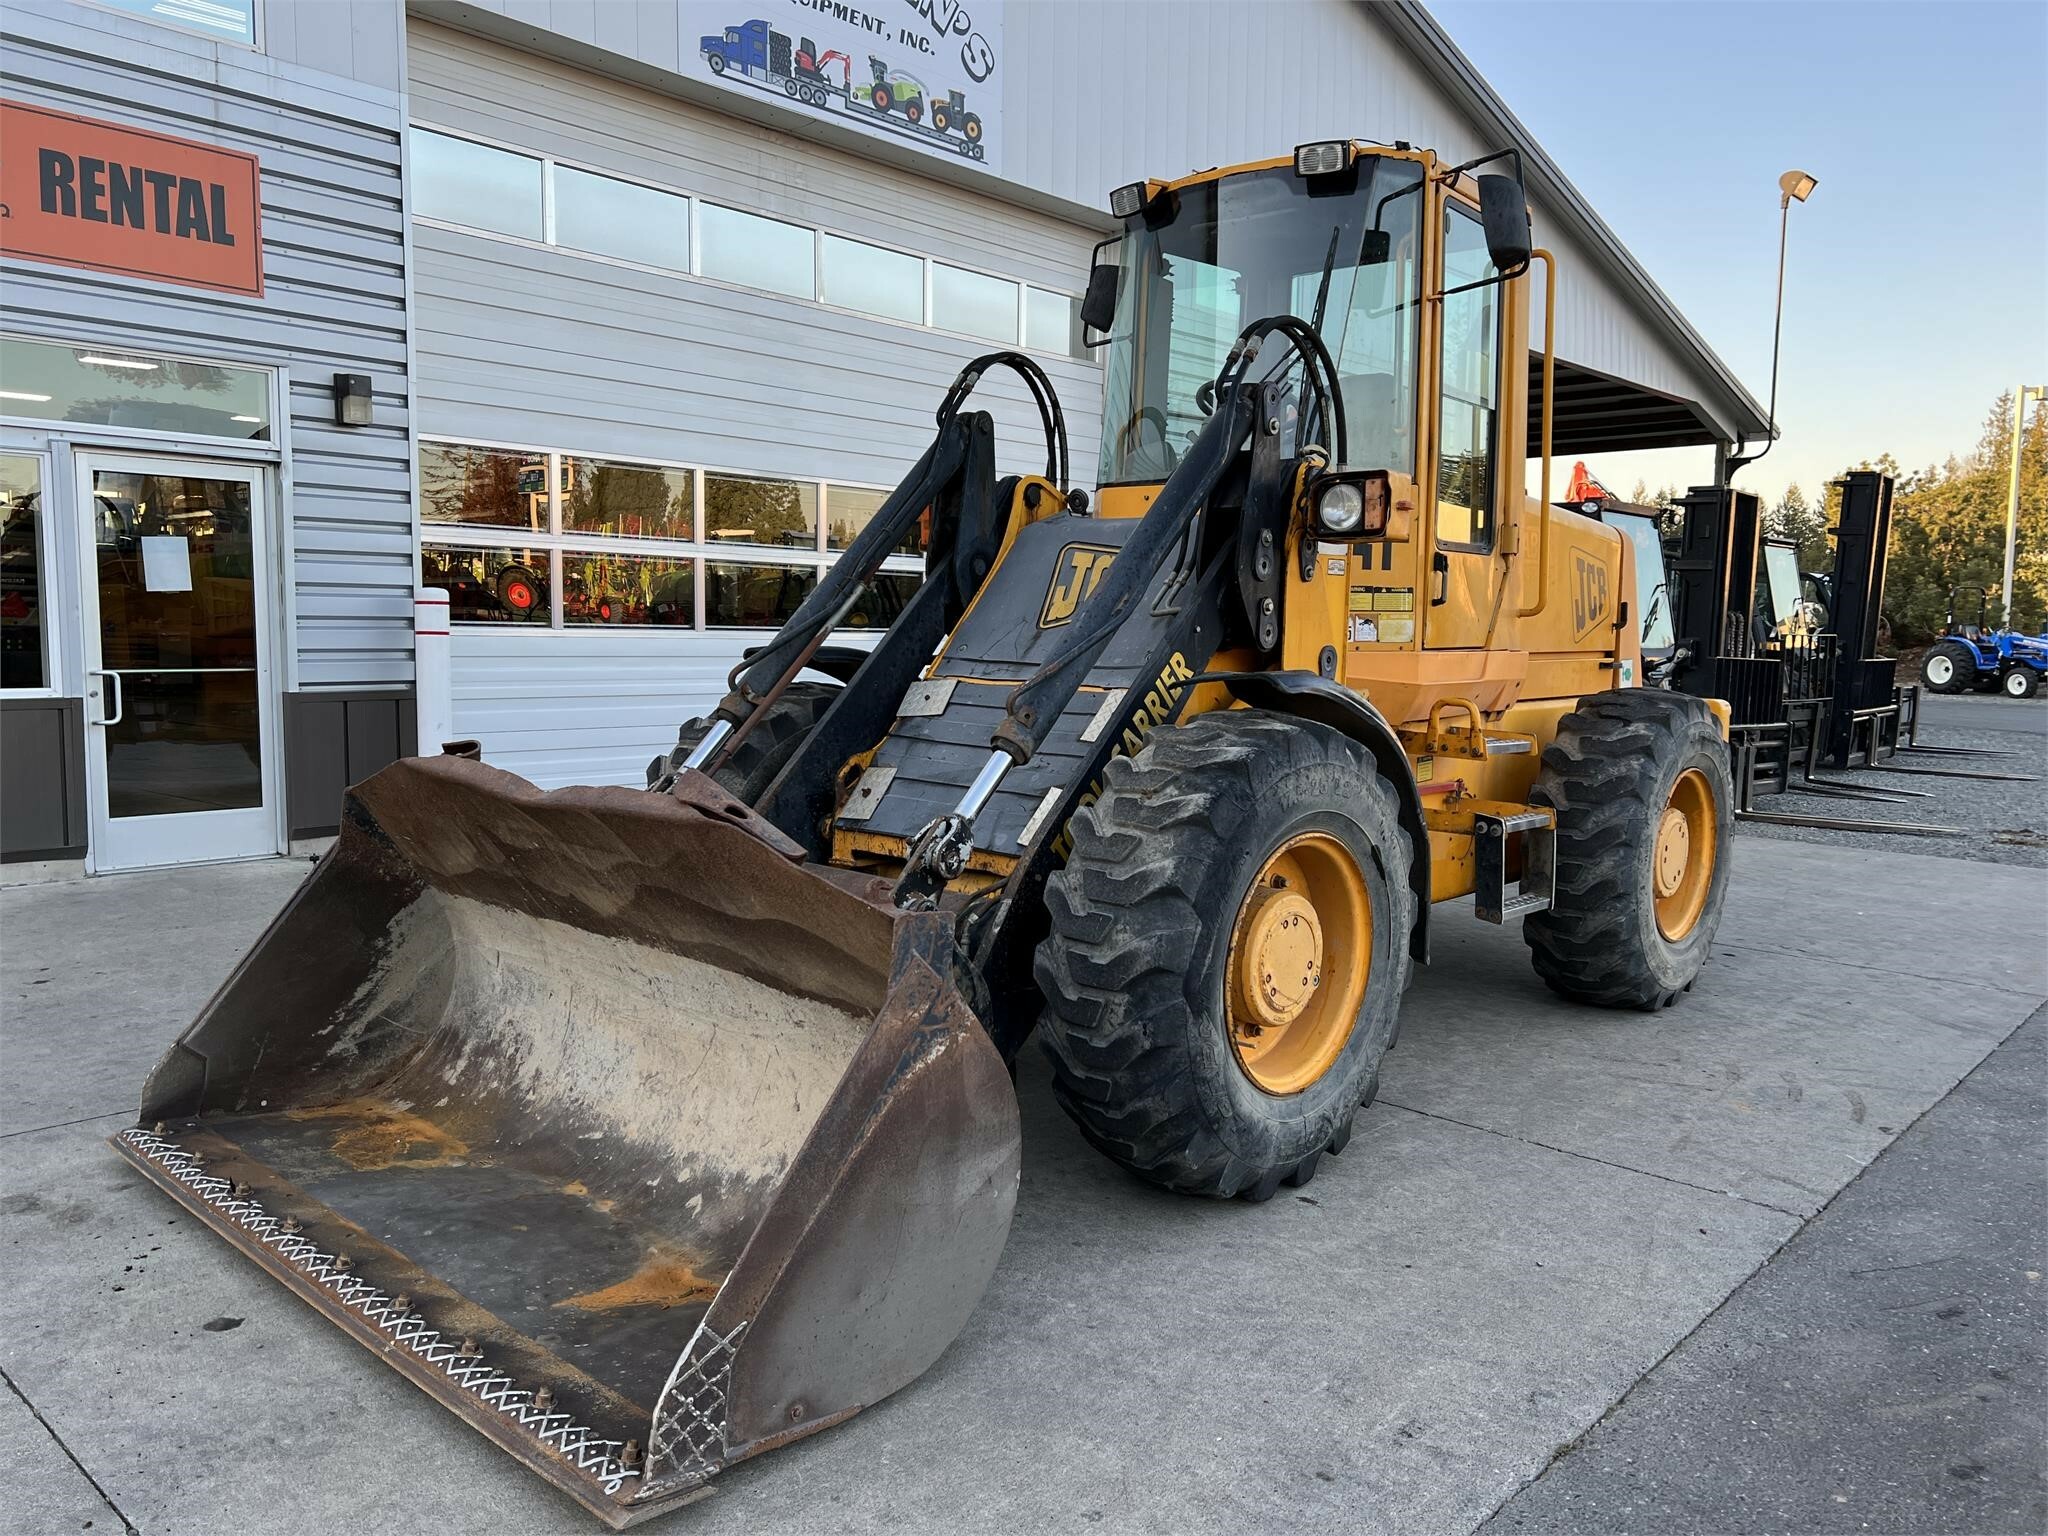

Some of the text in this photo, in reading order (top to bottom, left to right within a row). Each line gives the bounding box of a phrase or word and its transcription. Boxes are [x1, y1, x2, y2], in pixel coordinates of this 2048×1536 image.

[792, 0, 936, 56] IPMENT, INC.
[38, 147, 236, 247] RENTAL
[1574, 556, 1608, 634] JCB
[1110, 650, 1195, 760] ARRIER
